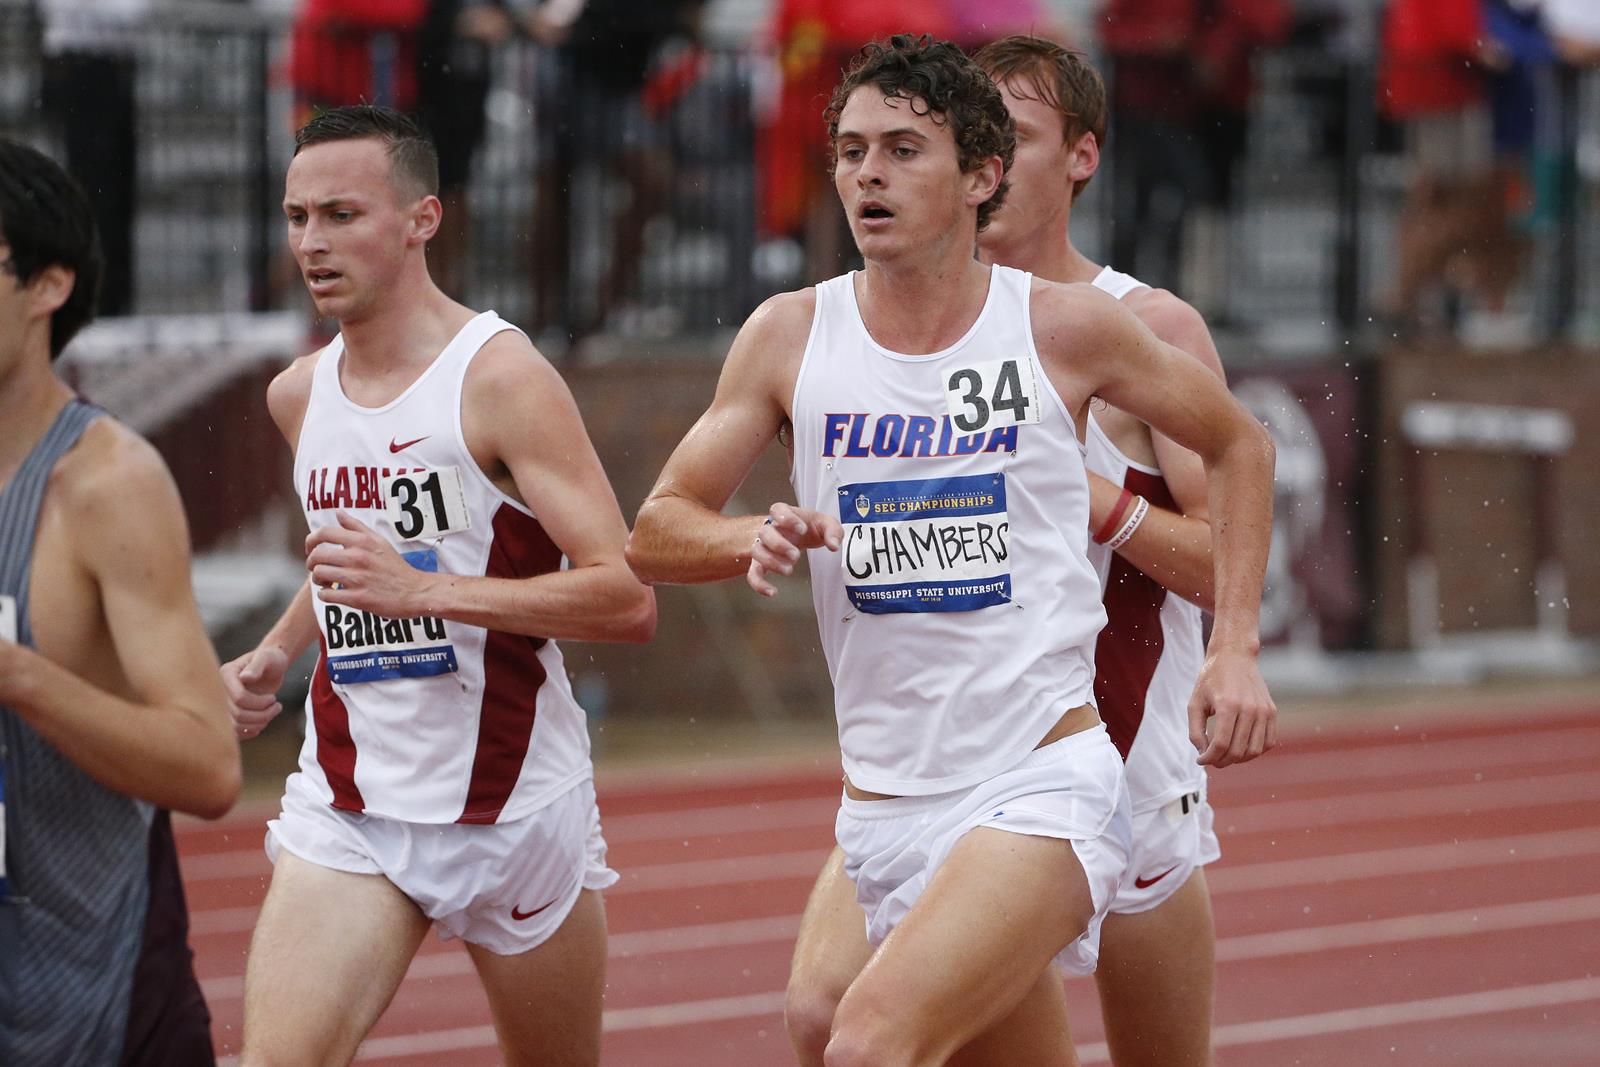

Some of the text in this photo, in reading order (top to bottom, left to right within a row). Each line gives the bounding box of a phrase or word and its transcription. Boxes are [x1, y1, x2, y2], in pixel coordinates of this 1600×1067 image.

[948, 360, 1029, 432] 34
[307, 466, 426, 511] ALABA
[391, 471, 450, 539] 31
[874, 503, 897, 513] SEC
[899, 495, 994, 512] CHAMPIONSHIPS
[845, 521, 1009, 580] CHAMBERS
[855, 581, 1005, 600] MISSISSIPPI STATE UNIVERSITY
[331, 658, 375, 670] MISSISSIPPI
[378, 656, 400, 665] STATE
[401, 652, 448, 664] UNIVERSITY
